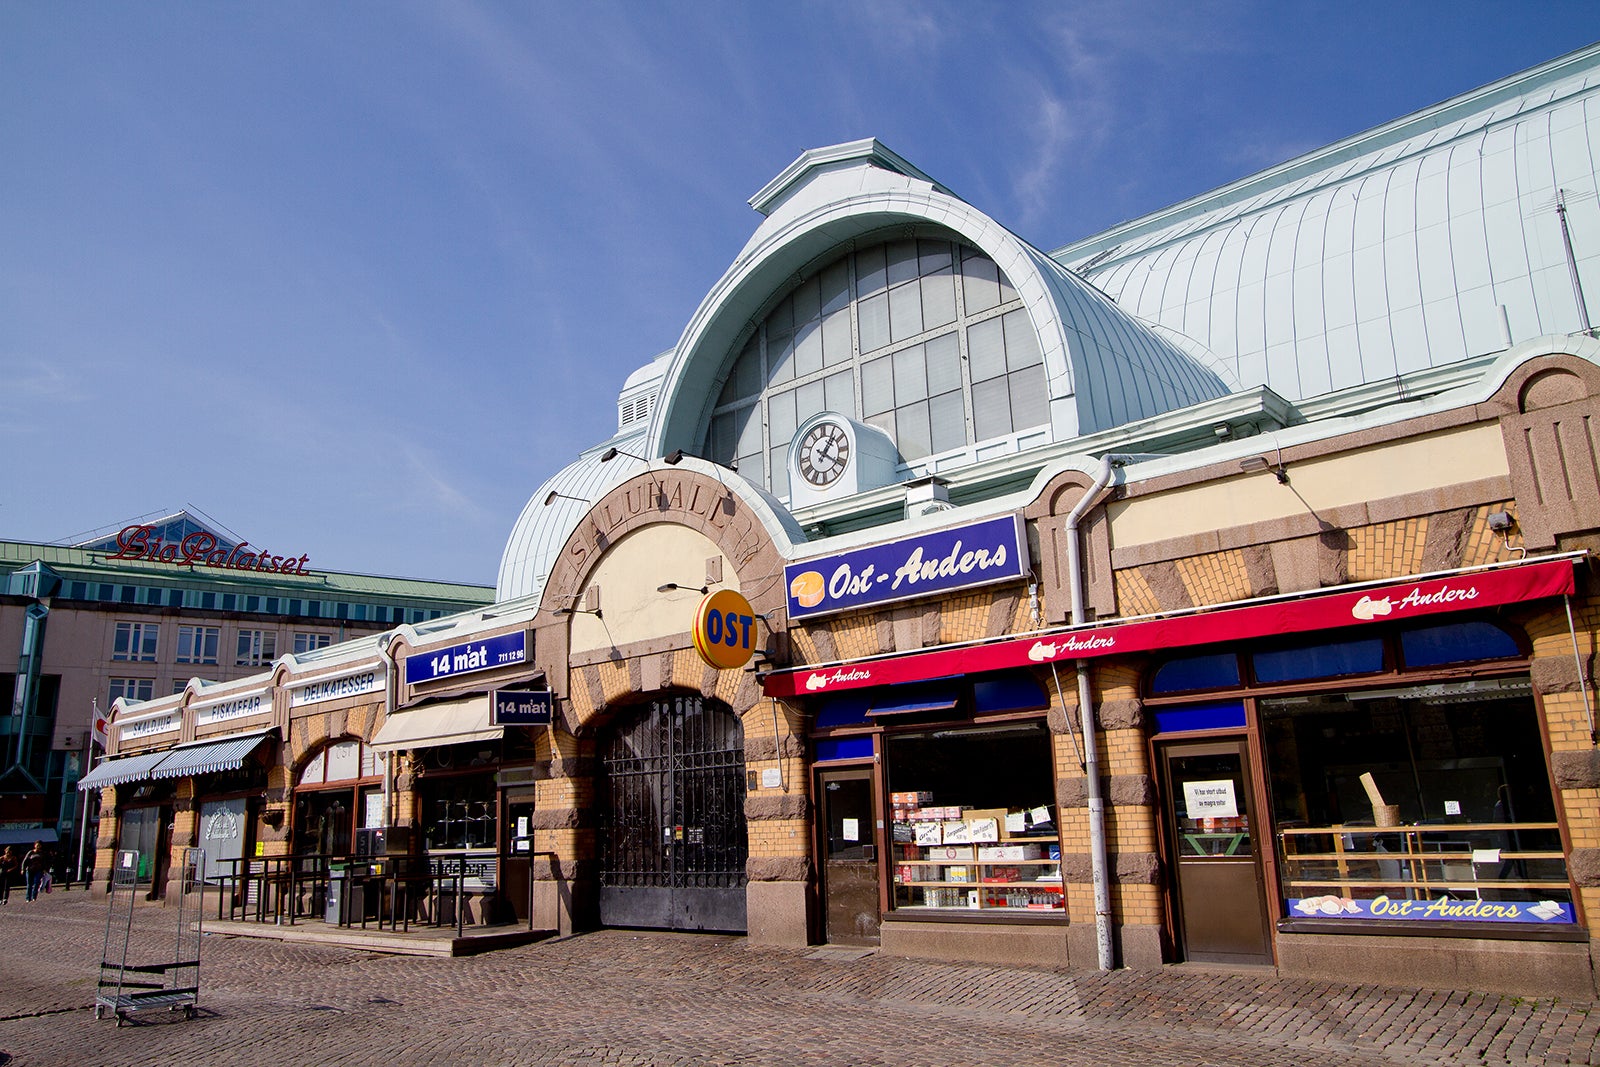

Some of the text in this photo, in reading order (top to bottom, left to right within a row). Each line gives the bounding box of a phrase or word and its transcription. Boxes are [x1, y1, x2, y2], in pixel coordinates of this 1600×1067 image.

[829, 540, 1007, 600] Ost-Anders
[707, 608, 753, 649] OST
[430, 654, 451, 676] 14
[498, 653, 508, 662] 711
[508, 651, 516, 661] 12
[516, 649, 524, 659] 96
[304, 672, 375, 702] DELIKATESSER
[499, 701, 516, 714] 14
[133, 715, 172, 736] SKALDJUR
[1370, 895, 1522, 919] Ost-Anders
